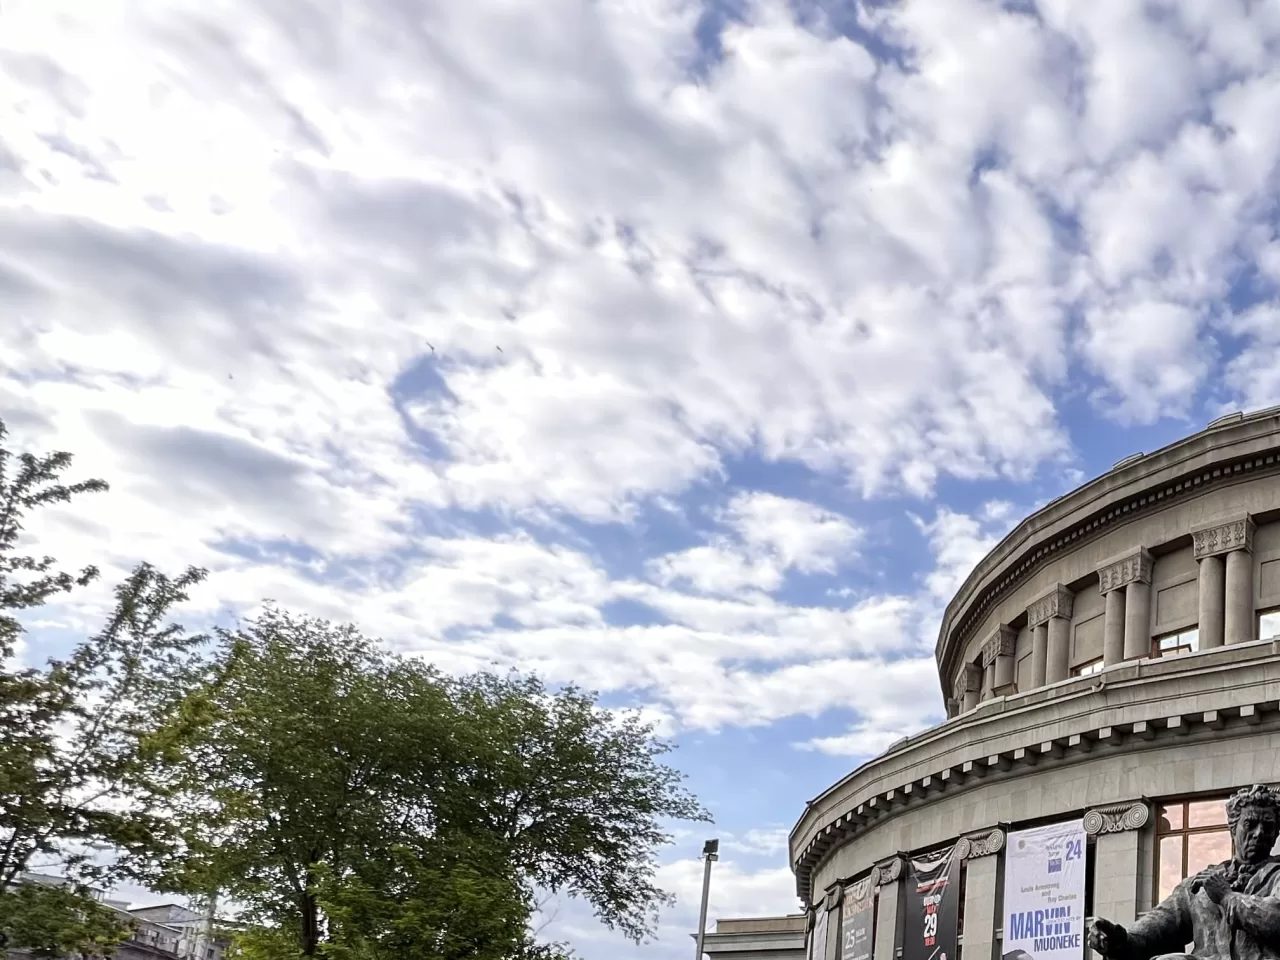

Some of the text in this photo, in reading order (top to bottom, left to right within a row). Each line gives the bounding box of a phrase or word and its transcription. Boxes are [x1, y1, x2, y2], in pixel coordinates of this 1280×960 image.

[1066, 839, 1082, 861] 24
[923, 913, 937, 937] 29
[1010, 906, 1071, 941] MARVIN
[844, 928, 855, 949] 25
[1034, 933, 1080, 952] MUONEKE
